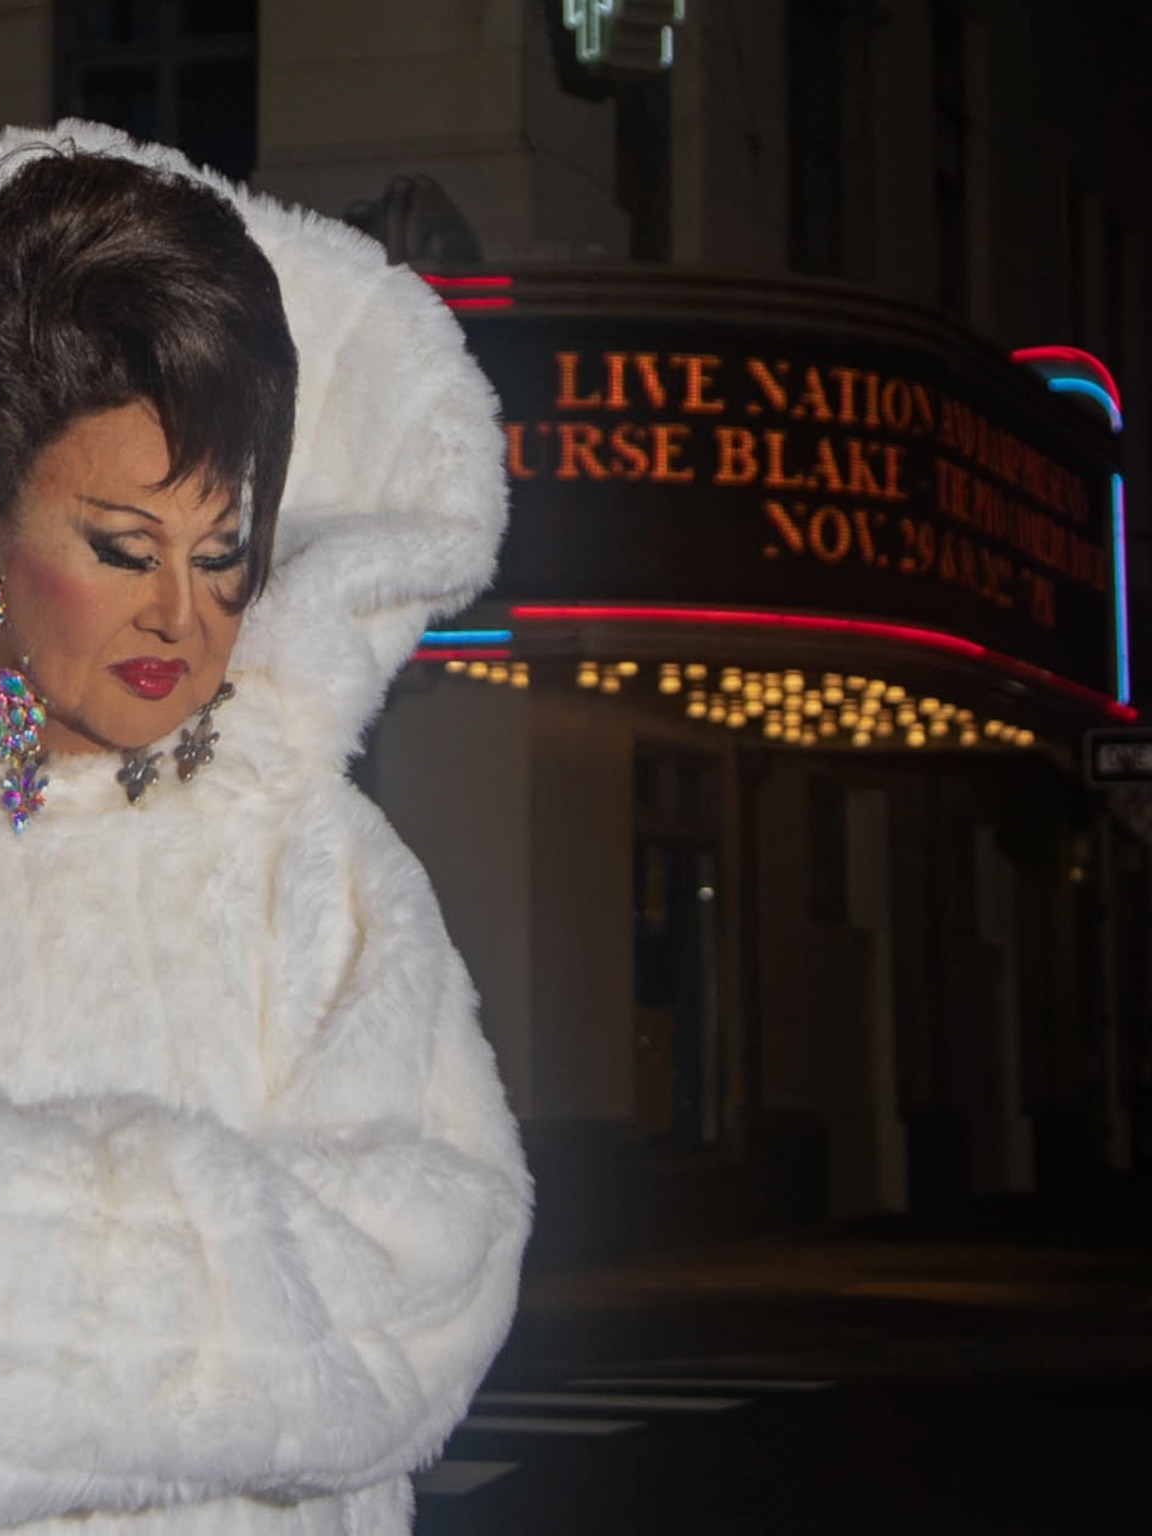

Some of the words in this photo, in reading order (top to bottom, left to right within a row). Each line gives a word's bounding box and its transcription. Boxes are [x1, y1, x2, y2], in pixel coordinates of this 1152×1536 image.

[554, 351, 726, 414] LIVE
[746, 357, 934, 437] NATION
[714, 425, 909, 502] BLAKE
[763, 498, 889, 570] NOV.
